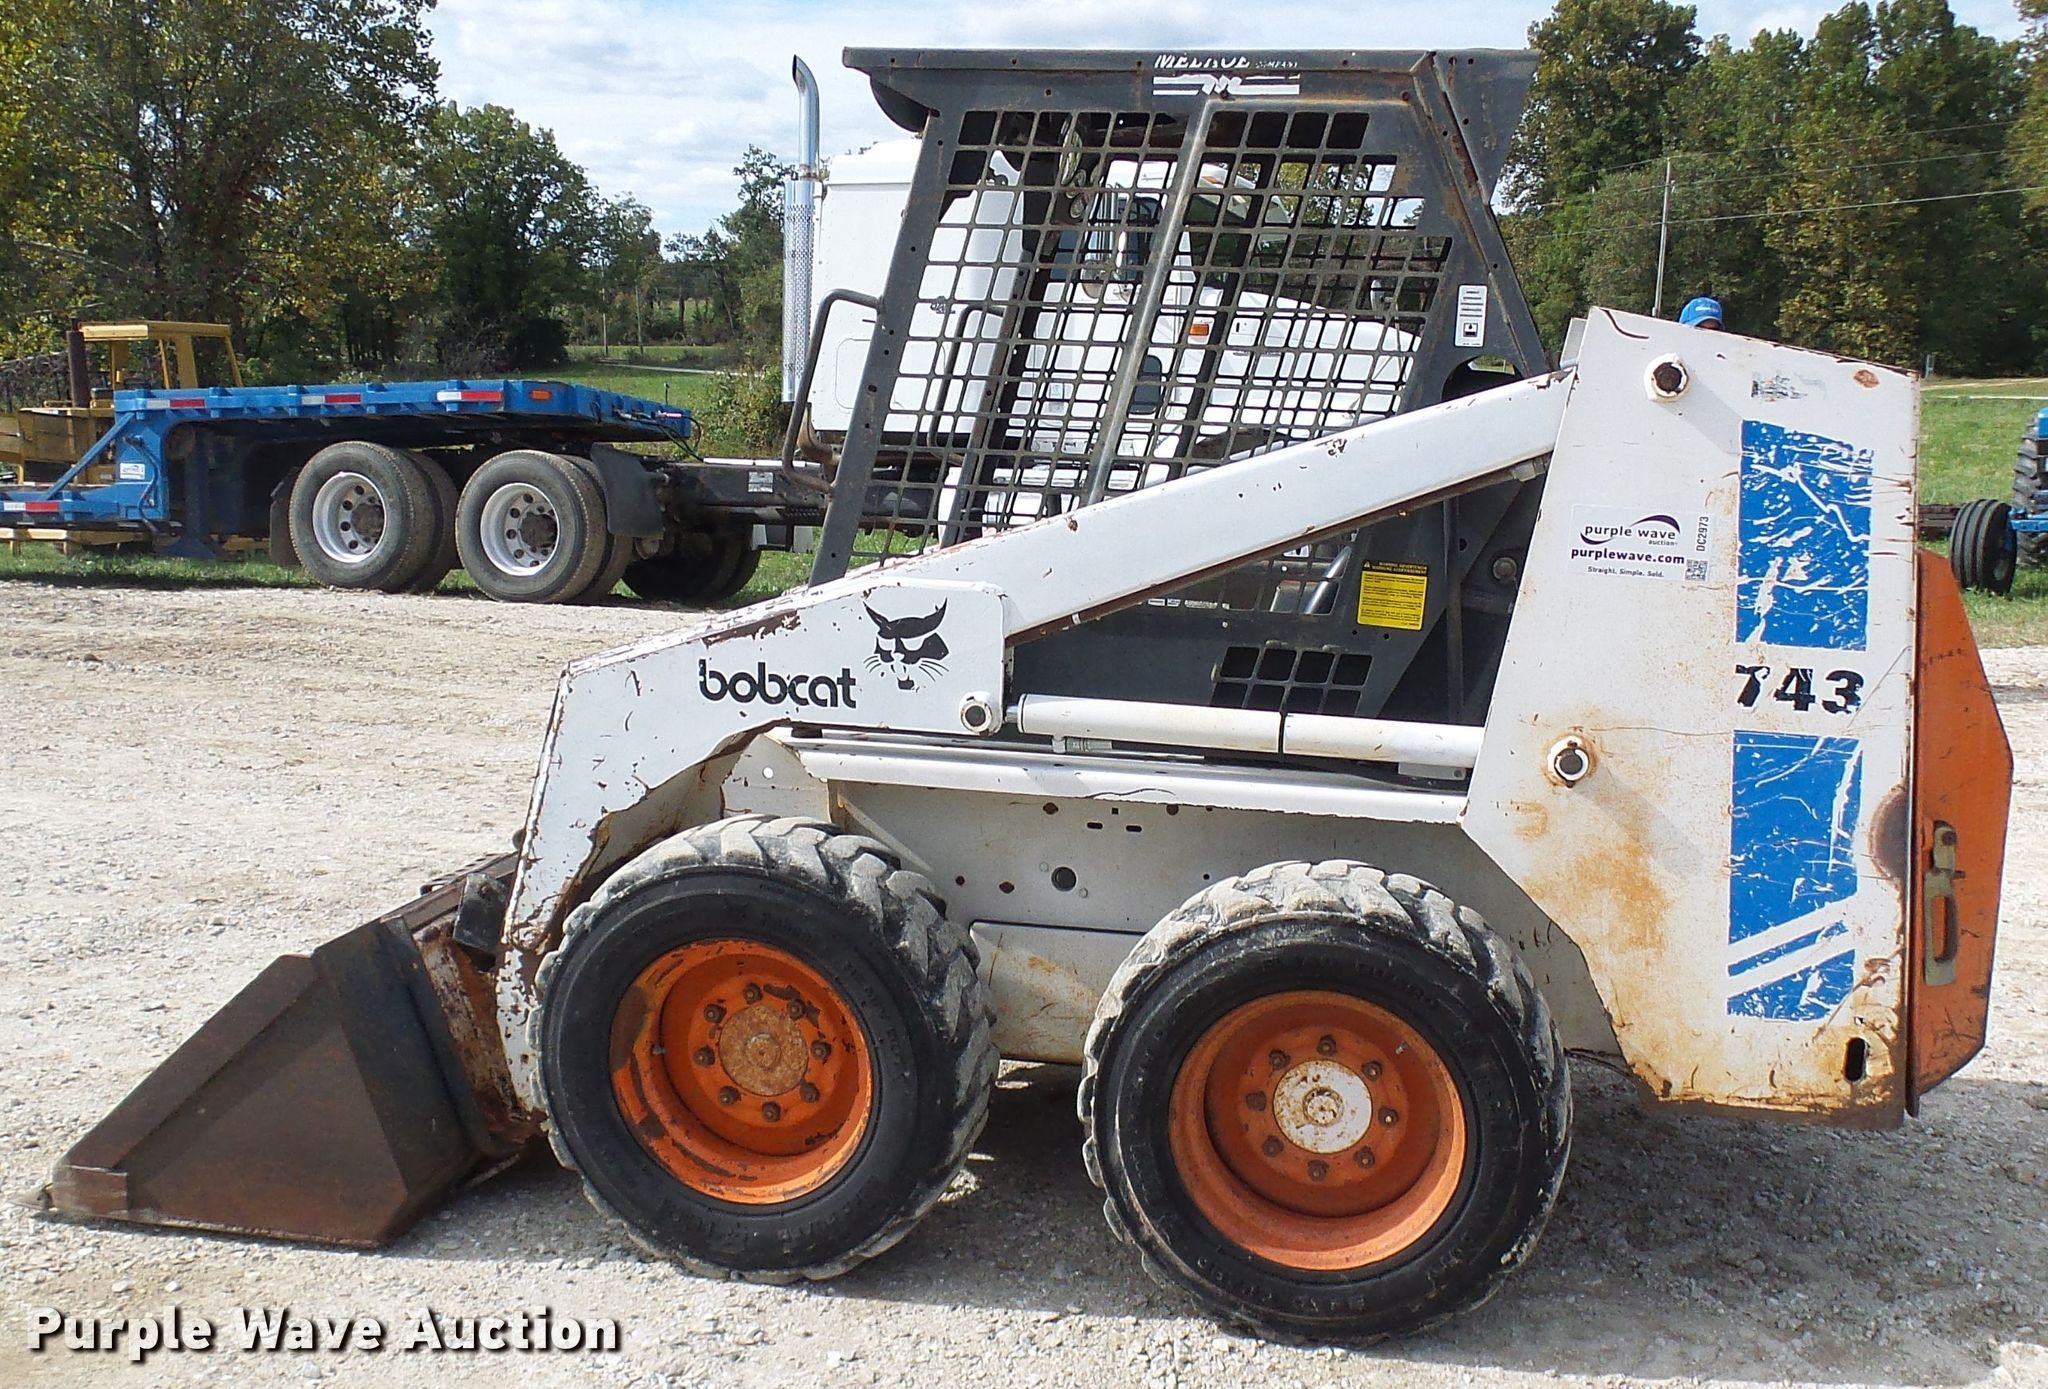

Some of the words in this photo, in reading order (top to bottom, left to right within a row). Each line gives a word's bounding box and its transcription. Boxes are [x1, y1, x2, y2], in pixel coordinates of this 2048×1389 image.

[1585, 526, 1632, 537] purple
[1638, 530, 1676, 539] wave
[1696, 516, 1709, 551] DC2973
[1571, 549, 1685, 564] purplewave.com
[1588, 565, 1617, 575] Straight.
[1619, 568, 1645, 577] Simple.
[1647, 570, 1664, 578] Sold.
[699, 659, 856, 708] bobcat
[1735, 664, 1864, 714] 743
